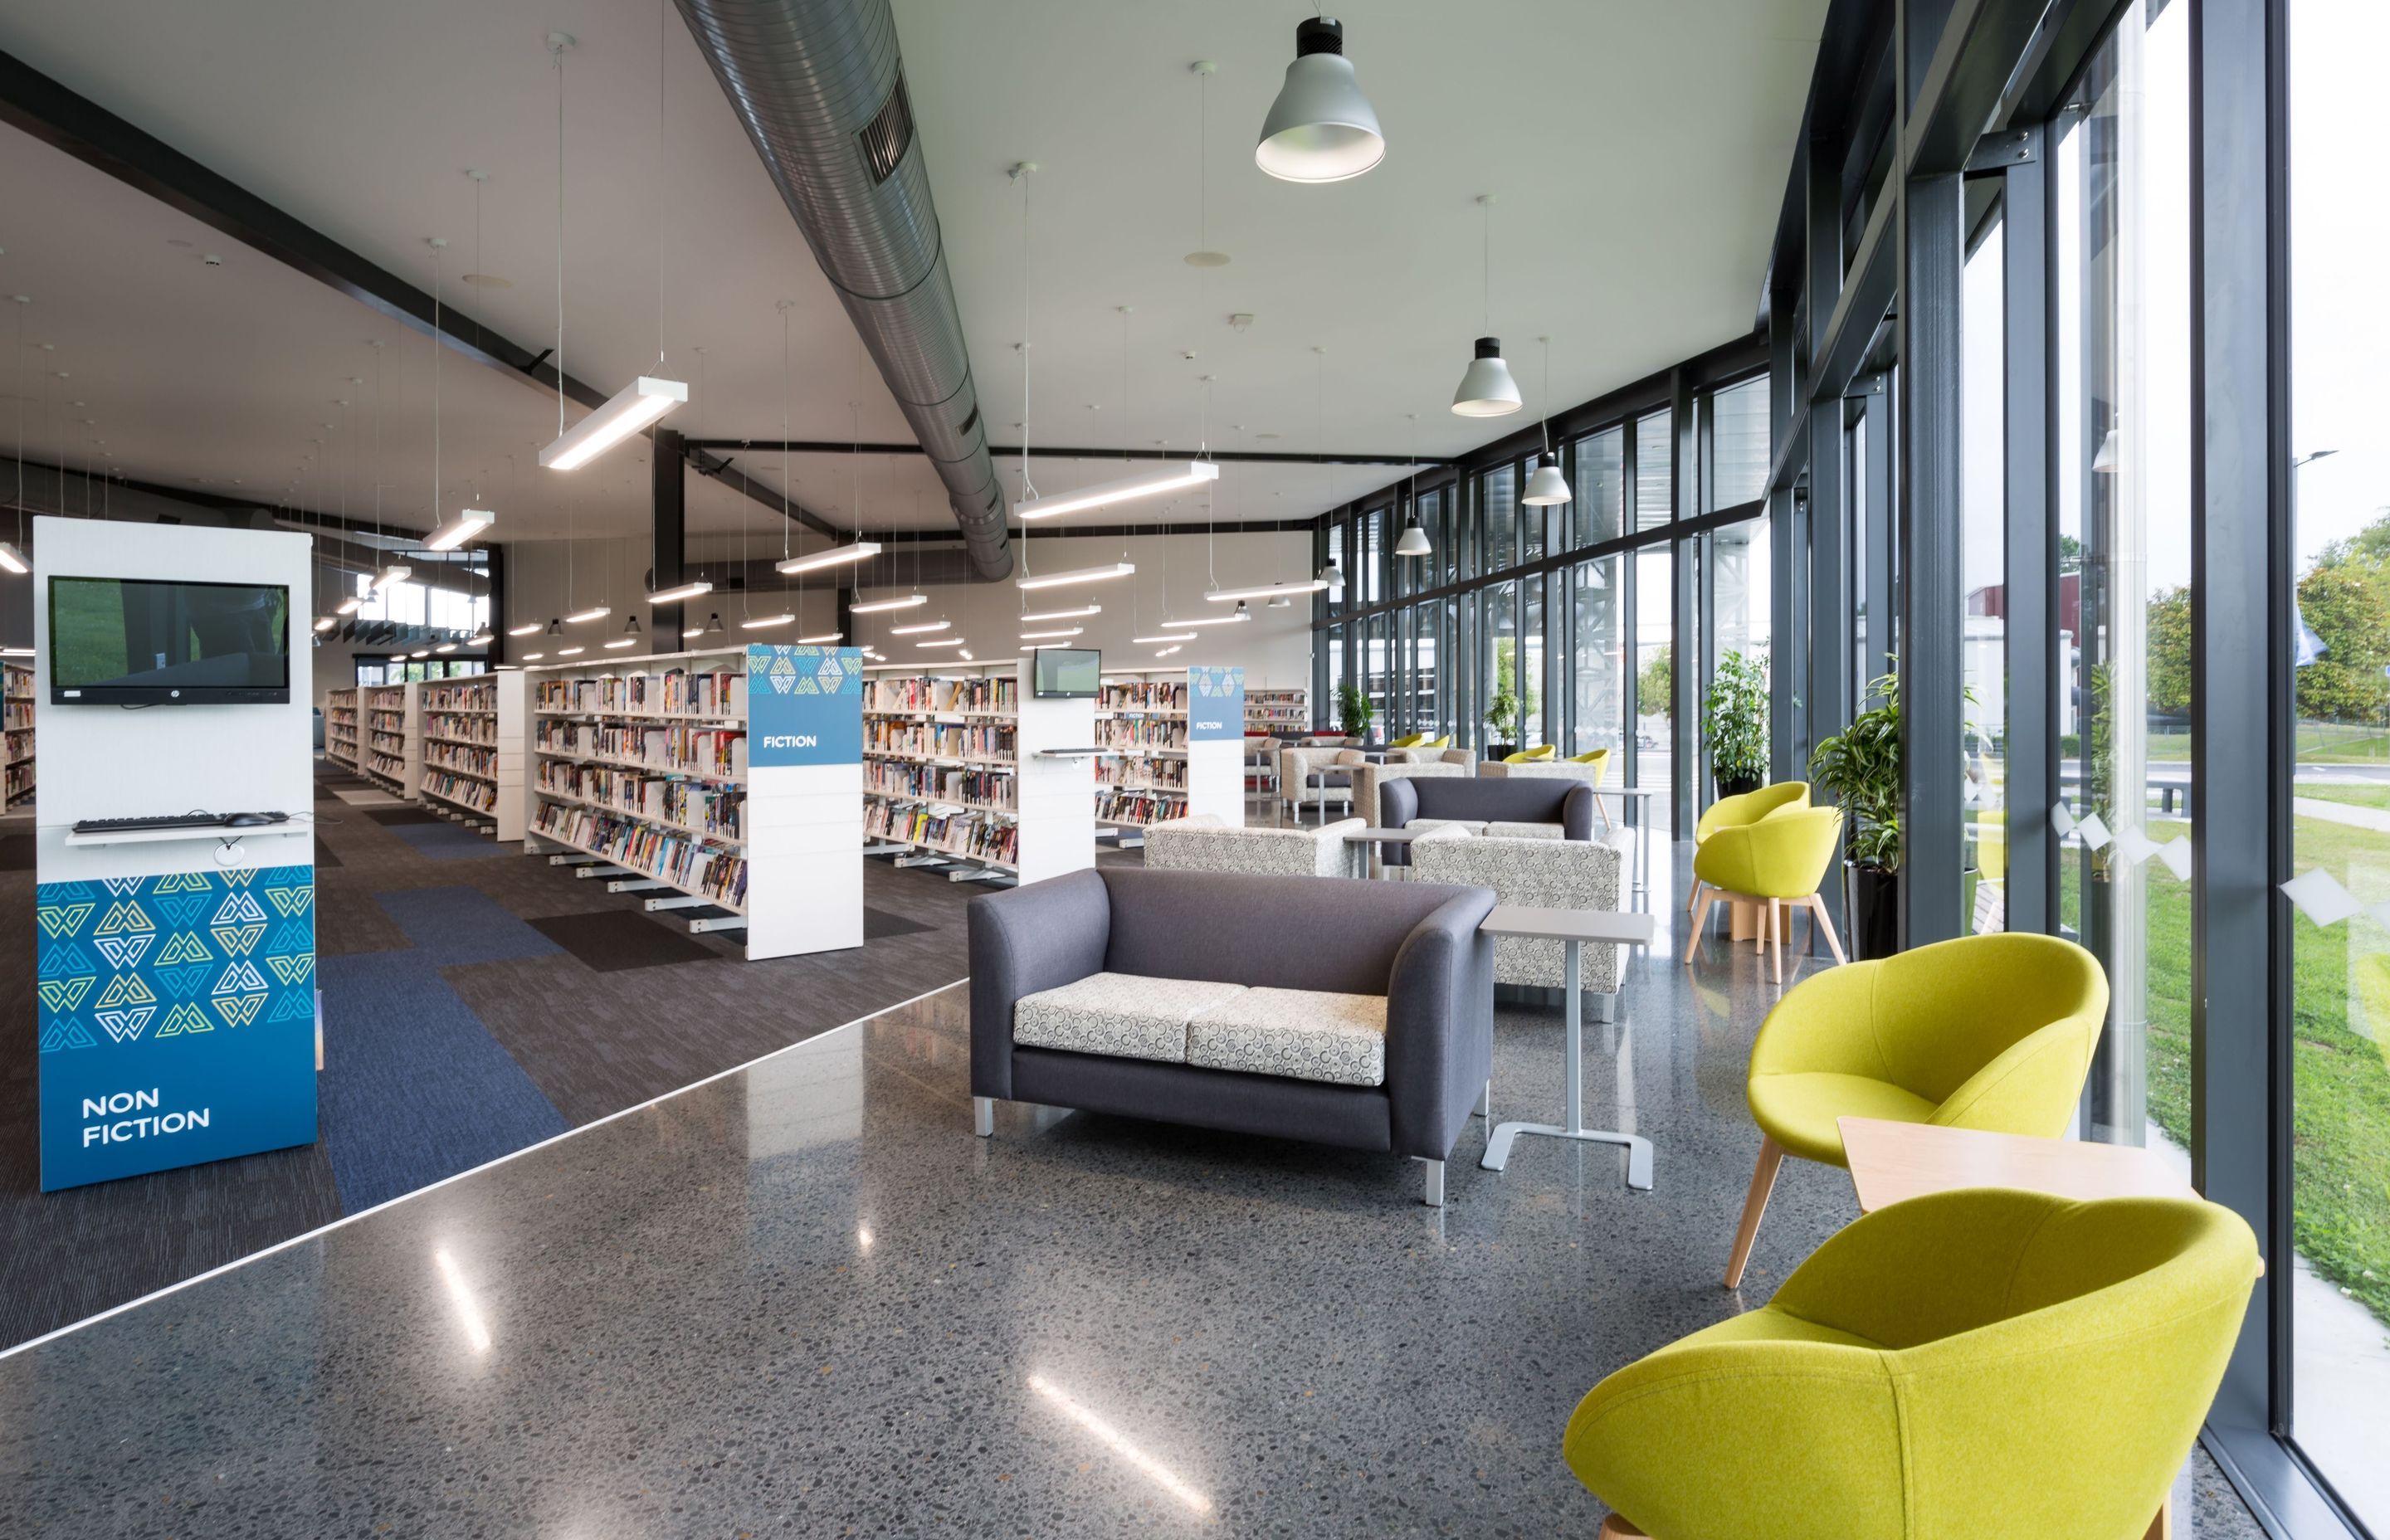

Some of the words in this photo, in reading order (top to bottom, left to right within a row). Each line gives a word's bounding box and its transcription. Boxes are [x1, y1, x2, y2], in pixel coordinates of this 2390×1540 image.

[1196, 721, 1222, 730] FICTION
[763, 735, 817, 748] FICTION
[83, 1088, 159, 1118] NON
[83, 1108, 209, 1148] FICTION
